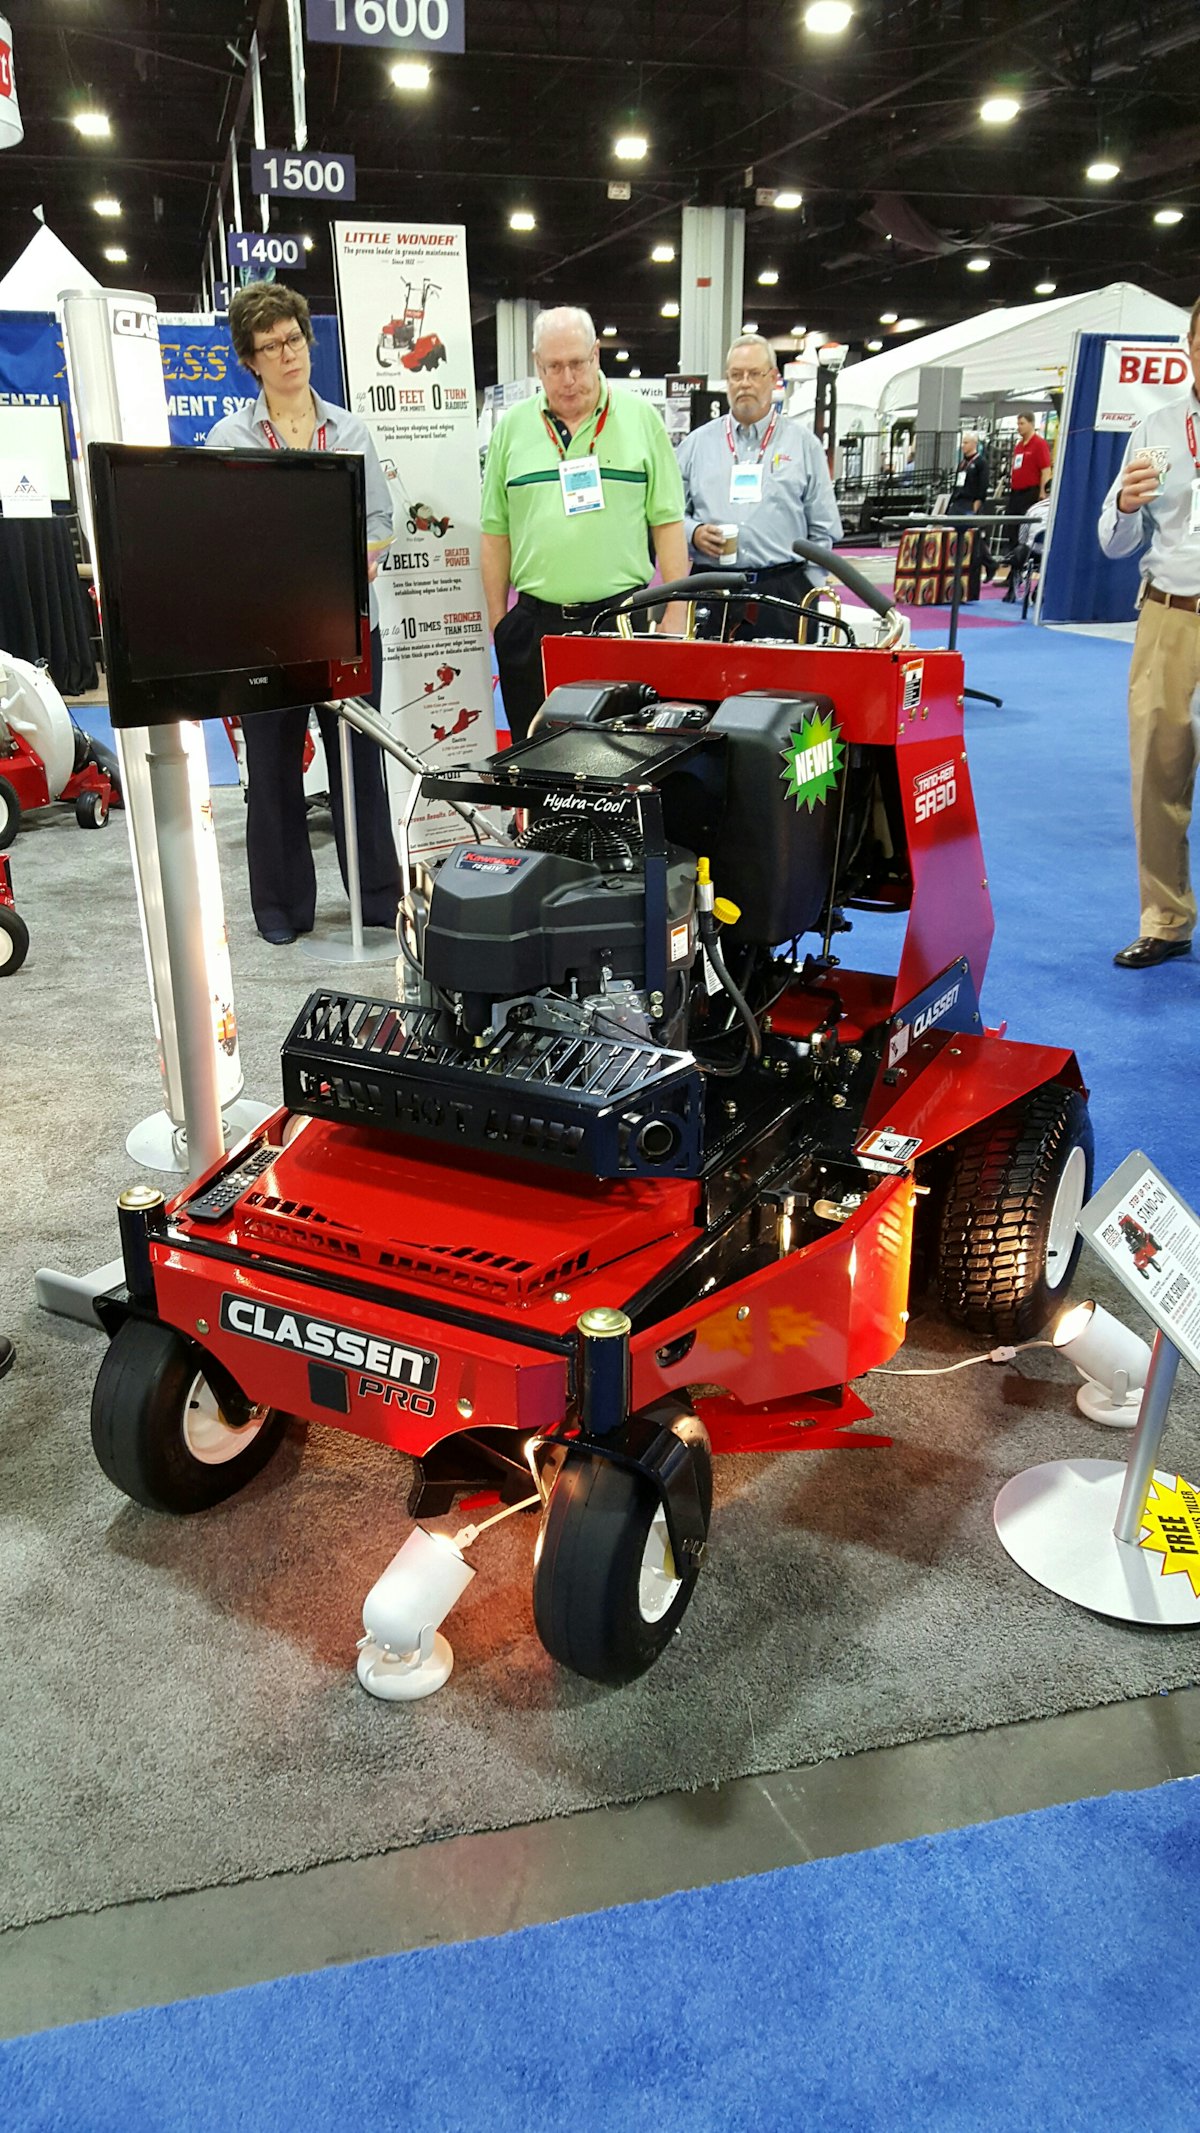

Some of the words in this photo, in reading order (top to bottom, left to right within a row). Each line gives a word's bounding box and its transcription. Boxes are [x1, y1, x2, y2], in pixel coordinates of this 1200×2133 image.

[328, 0, 449, 40] 1600
[263, 158, 345, 193] 1500
[345, 232, 391, 244] LITTLE
[397, 233, 456, 246] WONDER
[236, 238, 299, 264] 1400
[355, 248, 374, 256] proven
[376, 247, 393, 255] leader
[402, 248, 424, 256] grounds
[1118, 355, 1188, 385] BED
[368, 384, 396, 412] 100
[399, 390, 424, 404] FEET
[432, 384, 442, 410] 0
[444, 389, 467, 400] TURN
[641, 387, 664, 396] With
[163, 396, 217, 416] MENT
[445, 401, 468, 410] RADIUS
[411, 424, 428, 432] shaping
[392, 552, 429, 570] BELTS
[444, 548, 470, 557] GREATER
[446, 557, 470, 567] POWER
[444, 611, 482, 624] STRONGER
[401, 618, 416, 640] 10
[418, 621, 442, 632] TIMES
[444, 625, 462, 636] THAN
[464, 624, 482, 634] STEEL
[424, 650, 439, 658] growth
[795, 738, 834, 786] NEW!
[543, 793, 627, 814] Hydra-Cool
[915, 779, 957, 824] SA30
[913, 984, 960, 1039] CLASSEN
[1129, 1195, 1140, 1208] STEP
[1138, 1188, 1144, 1198] UP
[1142, 1182, 1151, 1190] TO
[1136, 1187, 1168, 1224] STAND-ON
[228, 1300, 424, 1385] CLASSEN
[358, 1376, 436, 1418] PRO
[1181, 1490, 1200, 1514] TILLER
[1158, 1516, 1199, 1554] FREE
